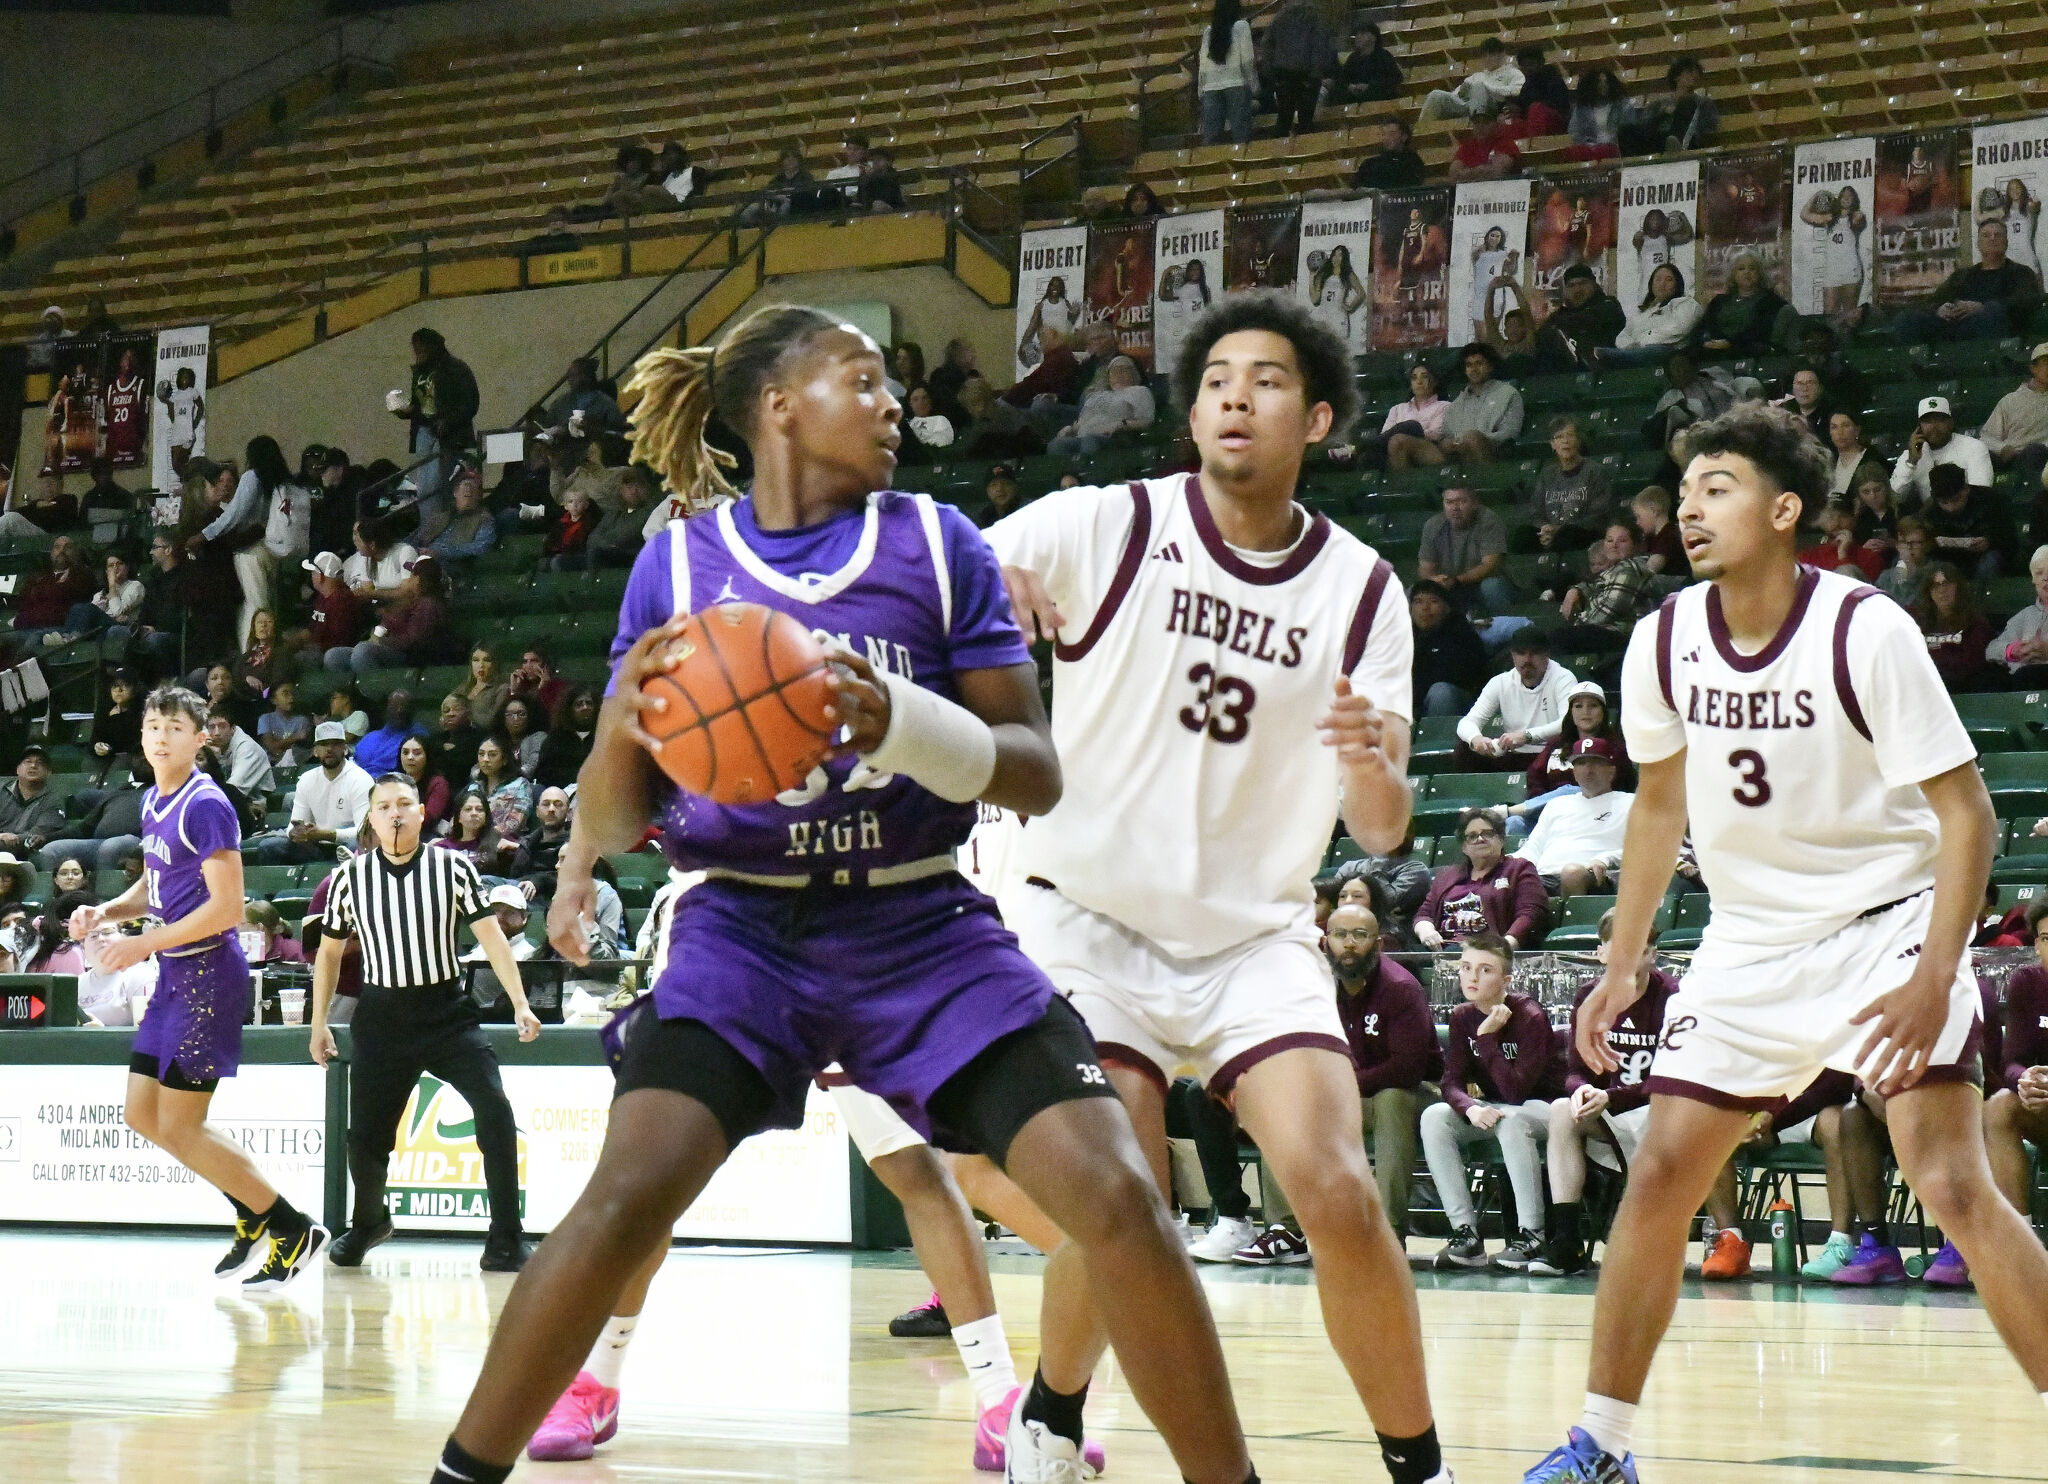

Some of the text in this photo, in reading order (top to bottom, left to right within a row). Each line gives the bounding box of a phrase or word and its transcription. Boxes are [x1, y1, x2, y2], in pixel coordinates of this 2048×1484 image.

[1797, 158, 1872, 184] PRIMERA
[1623, 181, 1696, 207] NORMAN
[1304, 220, 1369, 237] MANZANARES
[1162, 230, 1219, 257] PERTILE
[1023, 245, 1083, 271] HUBERT
[114, 407, 129, 423] 20
[1166, 589, 1308, 668] REBELS
[1179, 662, 1256, 744] 33
[1687, 685, 1817, 729] REBELS
[1728, 749, 1773, 807] 3
[784, 810, 882, 857] HIGH
[2018, 888, 2033, 898] 27
[7, 995, 28, 1019] POSS
[1076, 1063, 1106, 1085] 32
[37, 1104, 124, 1125] 4304 ANDRE
[60, 1129, 119, 1149] MIDLAND
[33, 1164, 195, 1184] CALL OR TEXT 432-520-3020
